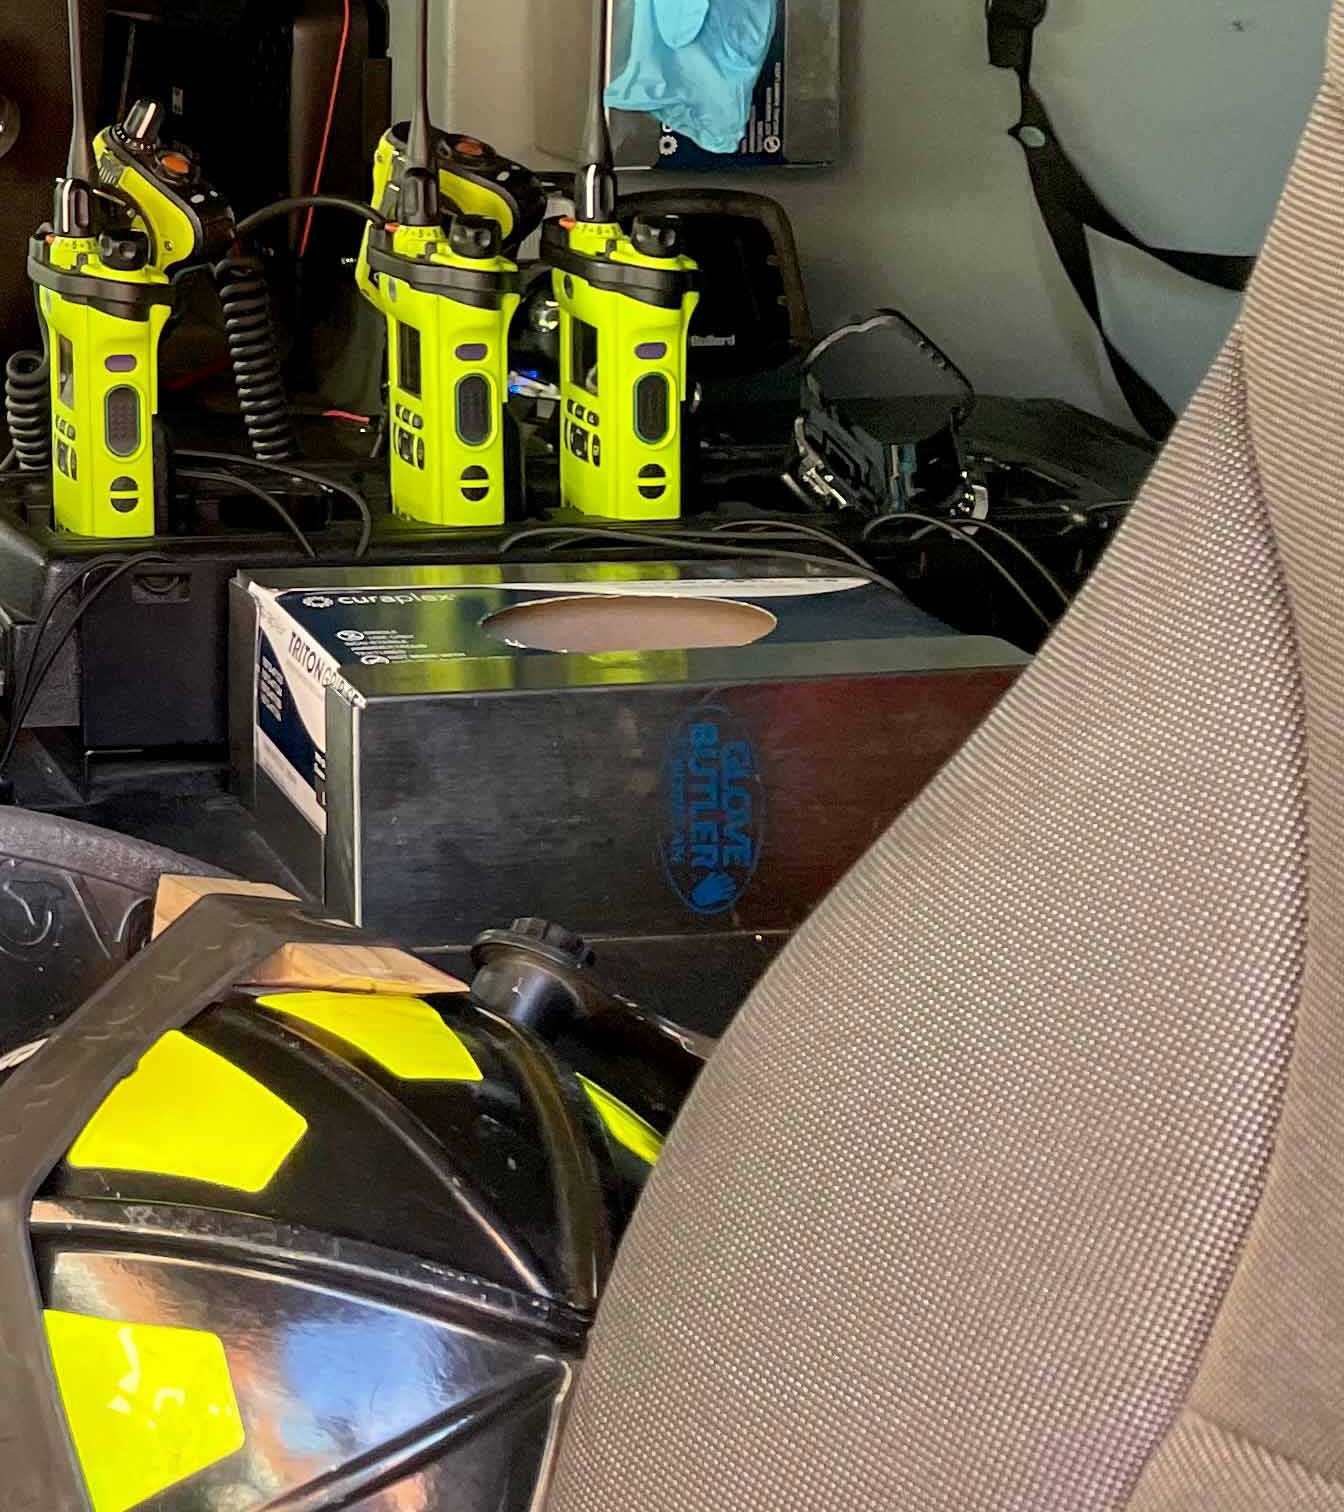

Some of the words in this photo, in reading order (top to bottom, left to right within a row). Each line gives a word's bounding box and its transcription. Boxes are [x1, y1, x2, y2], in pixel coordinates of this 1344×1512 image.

[337, 592, 454, 606] curaplex
[688, 722, 720, 869] BUTLER
[721, 741, 753, 867] GLOVE
